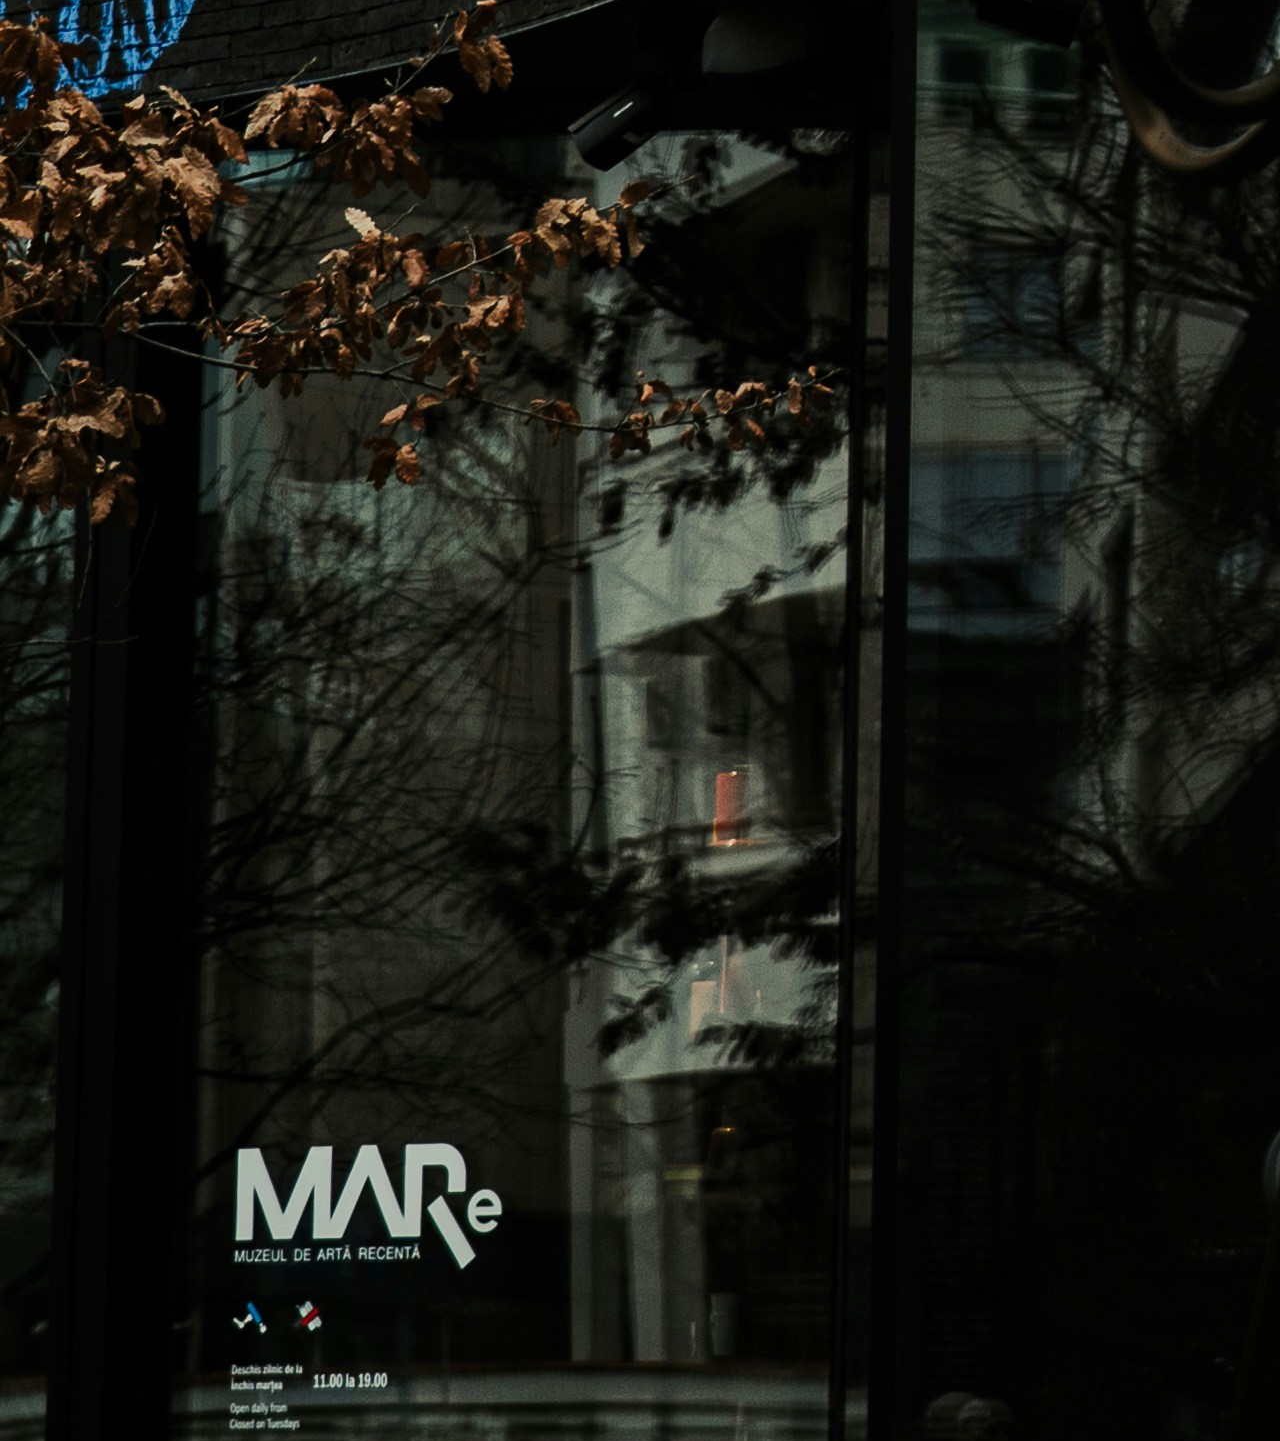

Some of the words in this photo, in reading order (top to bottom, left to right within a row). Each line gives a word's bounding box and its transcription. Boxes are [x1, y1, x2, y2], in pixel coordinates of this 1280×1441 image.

[234, 1248, 288, 1263] MUZEUL
[293, 1247, 312, 1262] DE
[317, 1245, 352, 1261] ARTĂ
[358, 1243, 422, 1261] RECENTĂ
[231, 1364, 262, 1375] Deschis
[313, 1373, 344, 1389] 11.00
[345, 1372, 356, 1388] la
[357, 1372, 388, 1388] 19.00
[229, 1402, 250, 1416] Open
[251, 1402, 269, 1415] daily
[270, 1402, 288, 1414] from
[229, 1418, 255, 1430] Closed
[255, 1420, 266, 1430] on
[267, 1418, 301, 1431] Tuesdays
